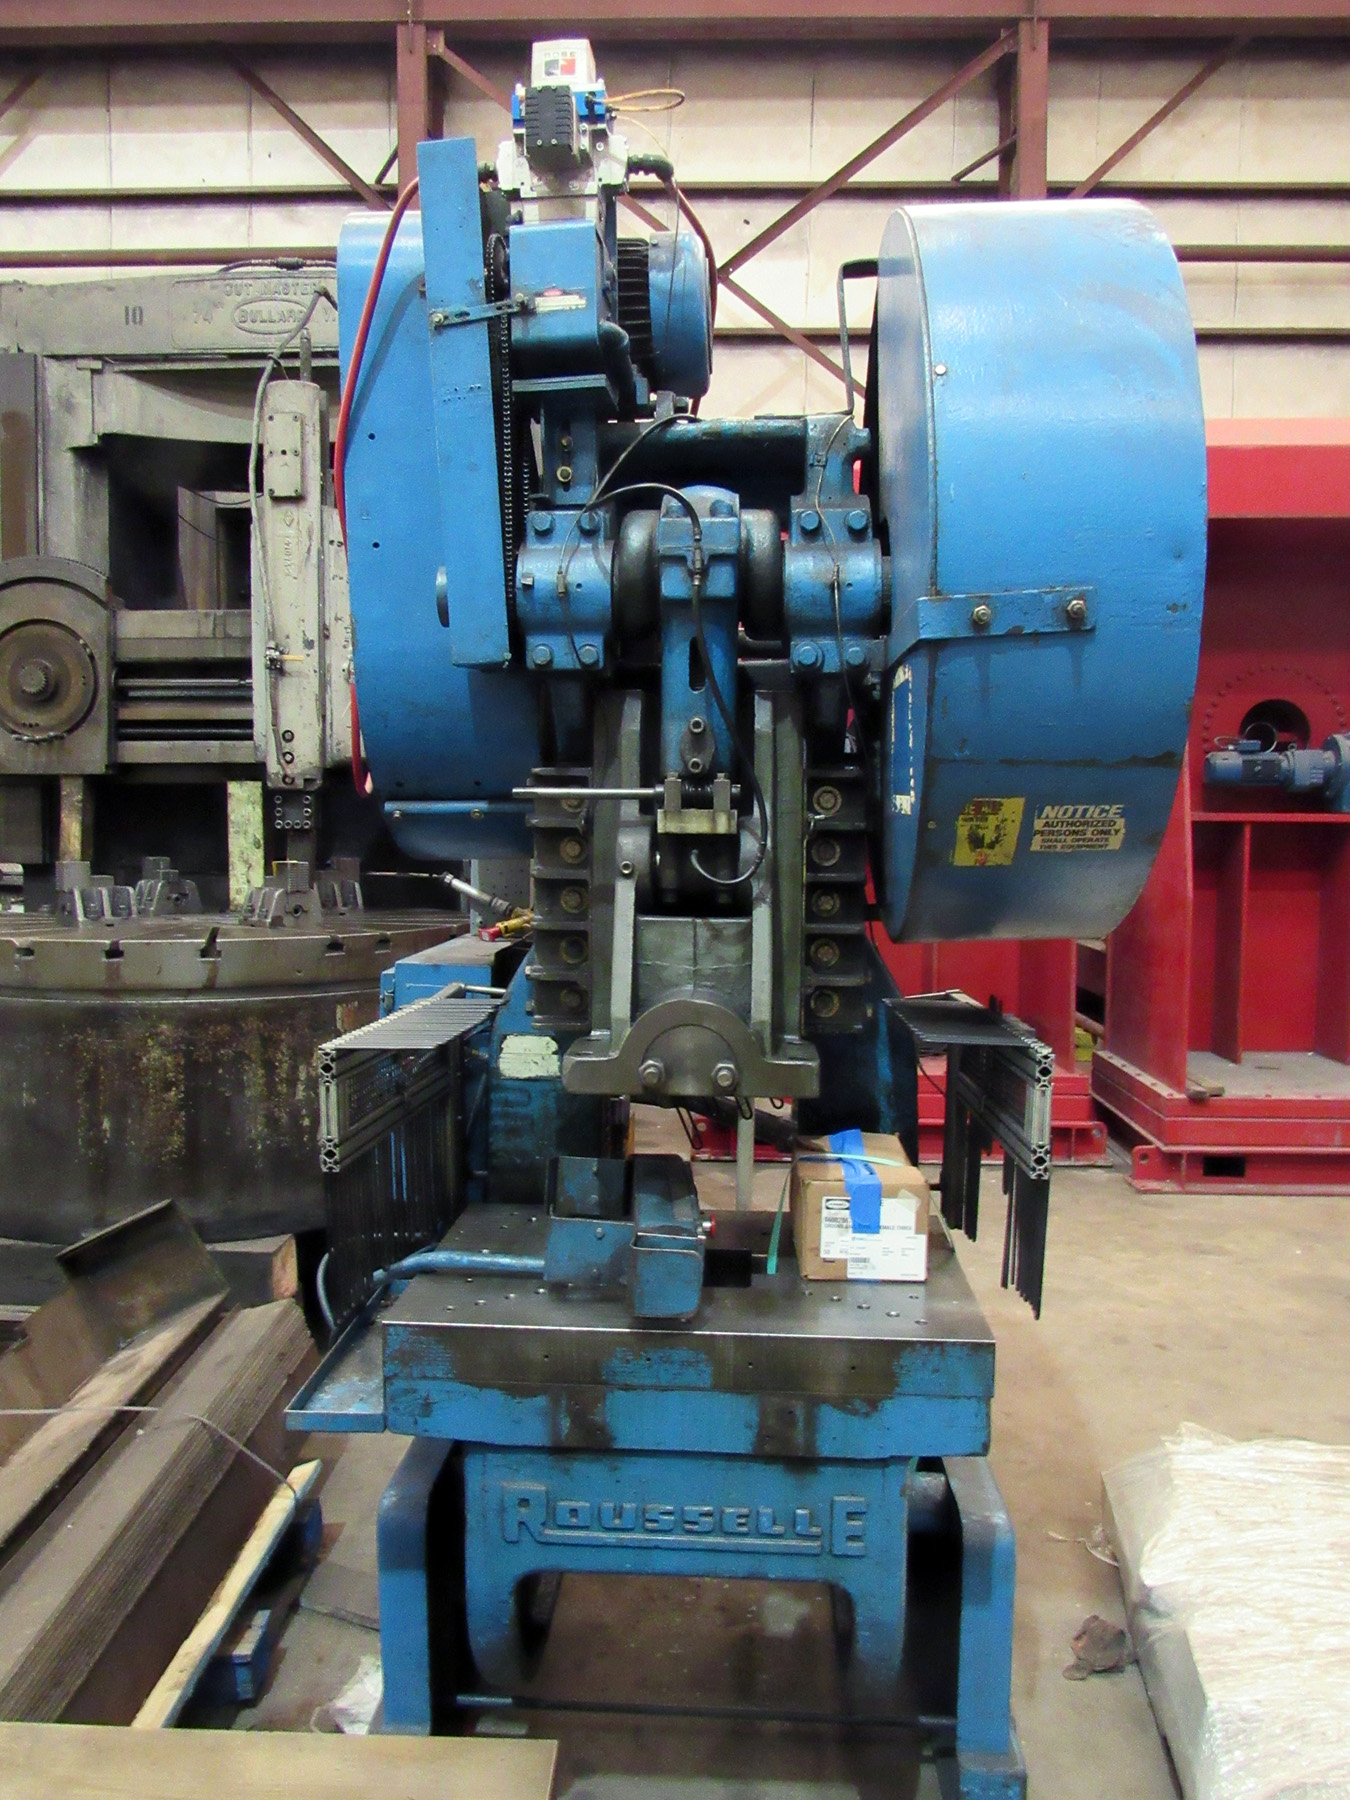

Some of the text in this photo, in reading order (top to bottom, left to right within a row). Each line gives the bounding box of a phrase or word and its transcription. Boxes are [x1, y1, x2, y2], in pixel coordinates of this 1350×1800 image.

[1041, 804, 1125, 819] NOTICE
[1042, 819, 1117, 828] AUTHORIZED
[1034, 828, 1121, 837] PERSONS ONLY
[501, 1482, 868, 1557] ROUSSELLE
